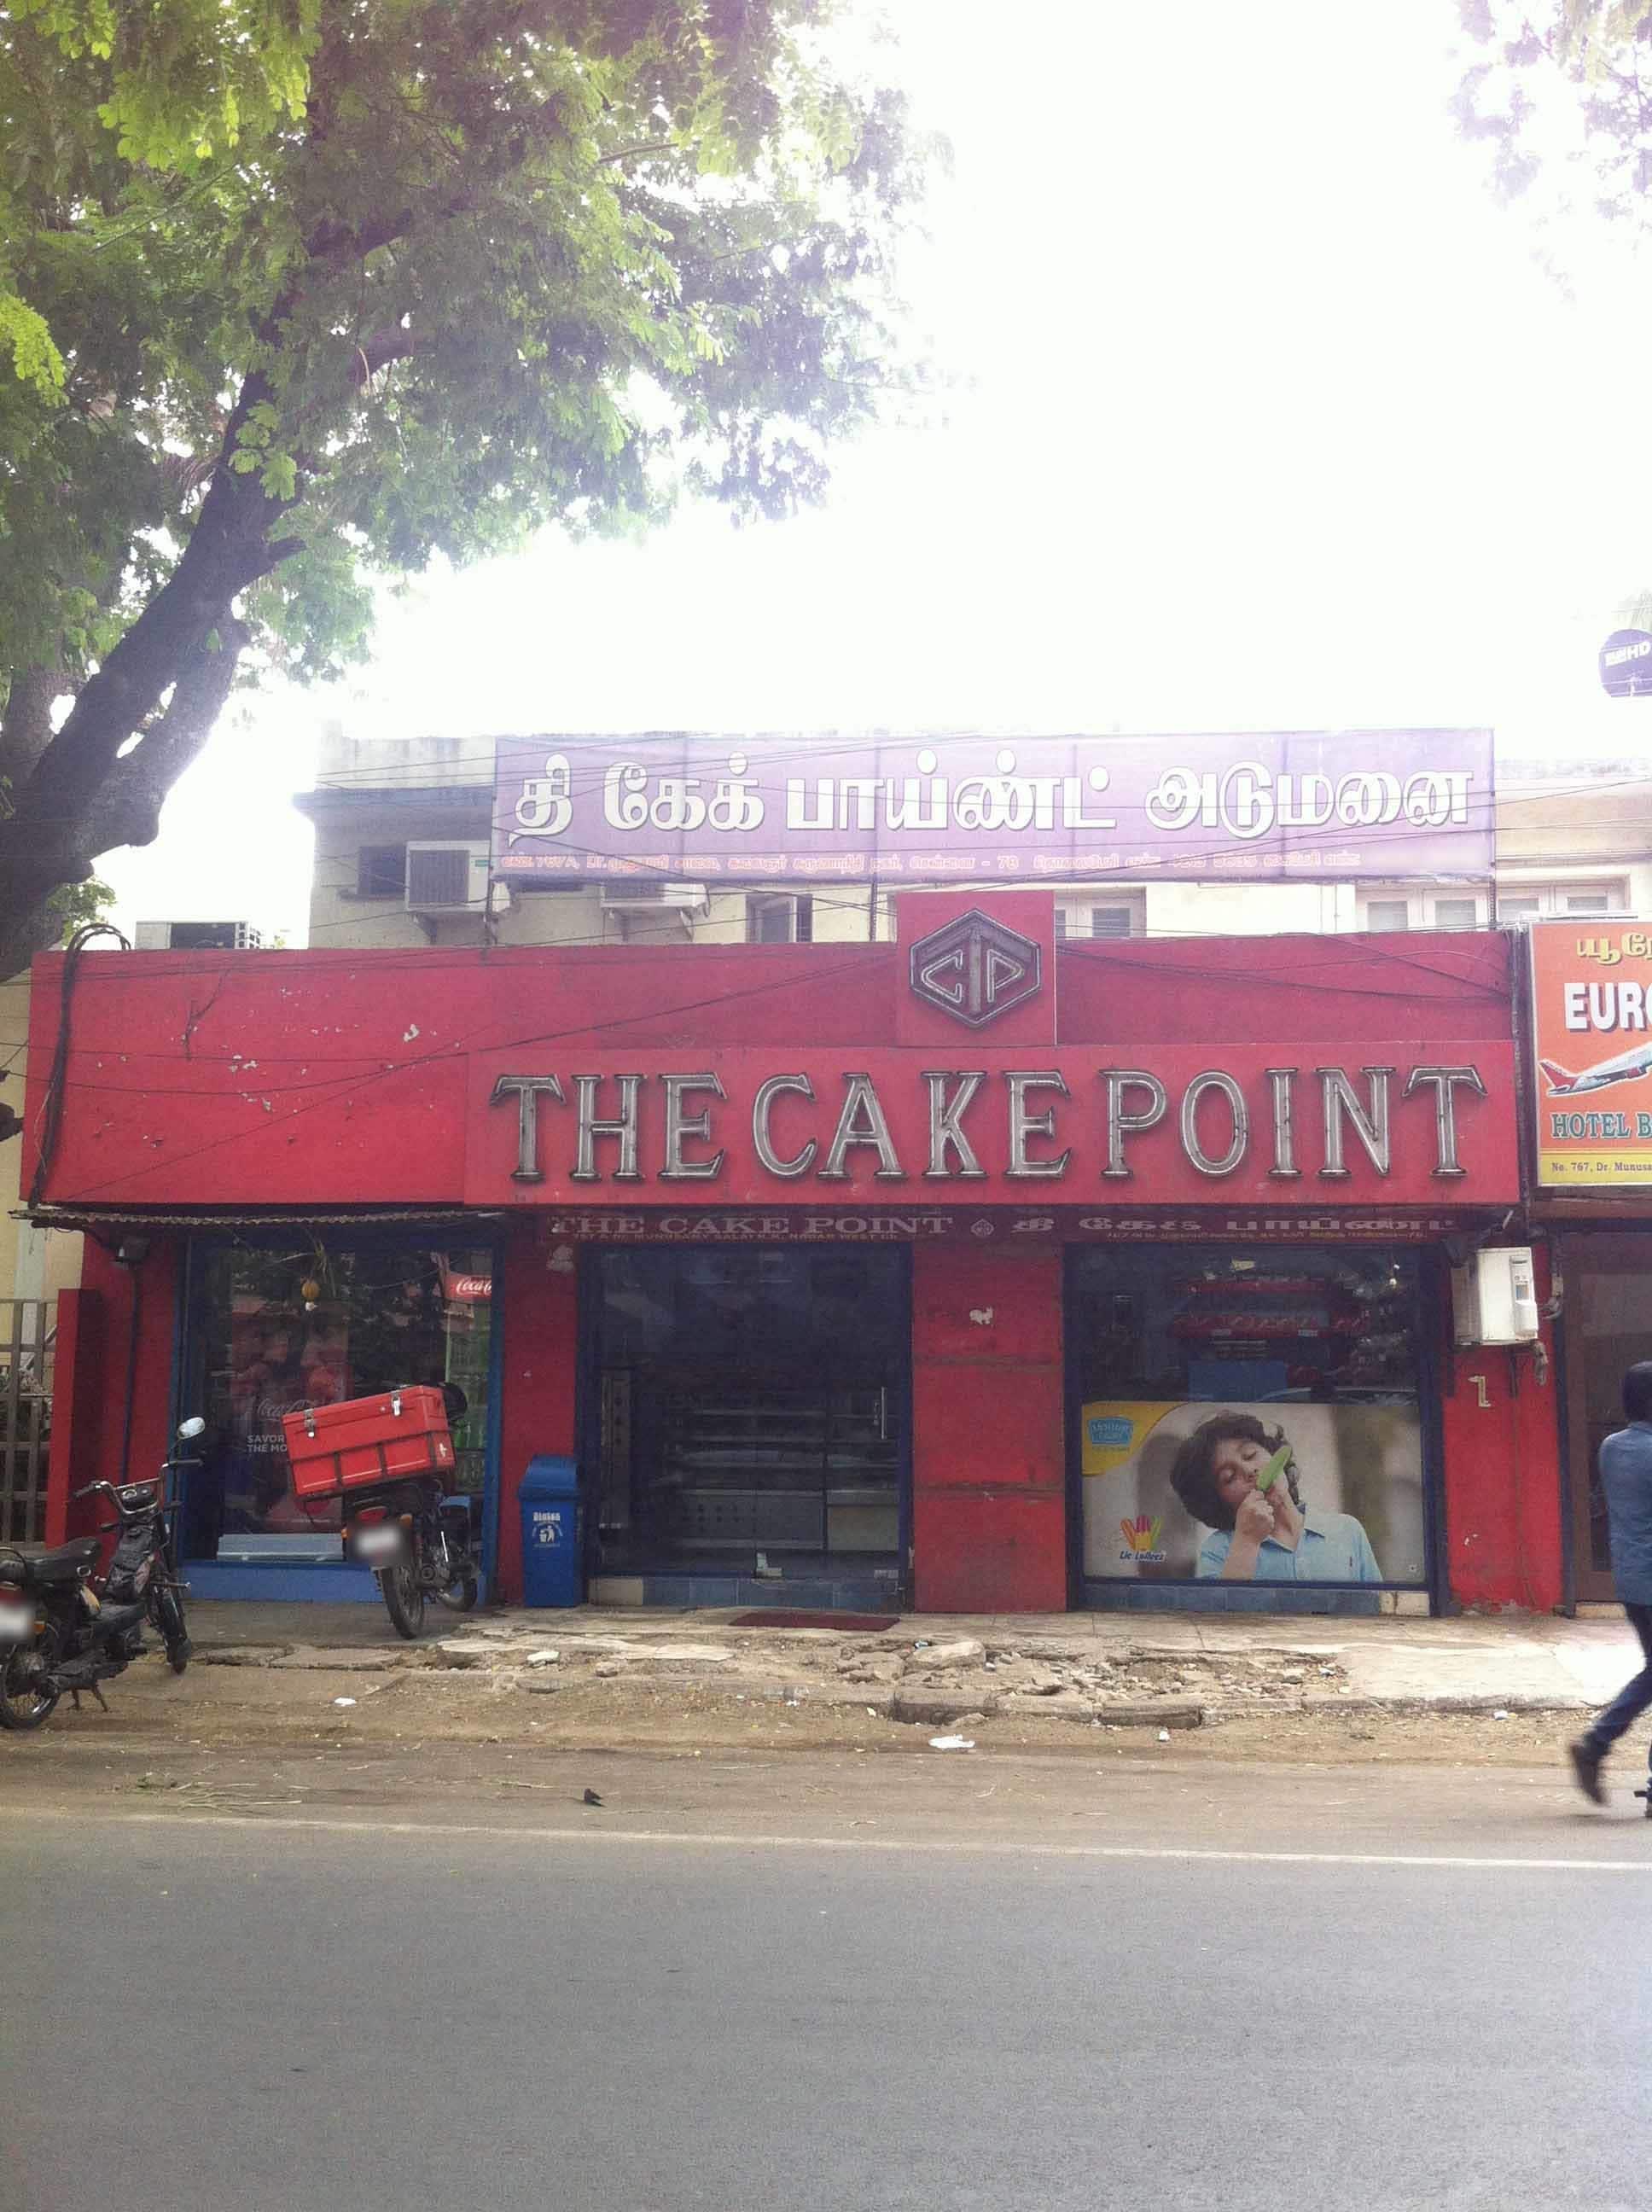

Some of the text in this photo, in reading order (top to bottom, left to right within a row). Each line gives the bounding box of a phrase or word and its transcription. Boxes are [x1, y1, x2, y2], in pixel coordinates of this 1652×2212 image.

[602, 751, 765, 832] கேக்
[1144, 760, 1475, 840] அடுமனை
[491, 1064, 1489, 1182] THE CAKE POINT
[1550, 1112, 1632, 1140] HOTEL
[547, 1215, 645, 1235] THE
[659, 1215, 788, 1235] CAKE
[806, 1216, 953, 1235] POINT
[247, 1444, 288, 1453] THE MO
